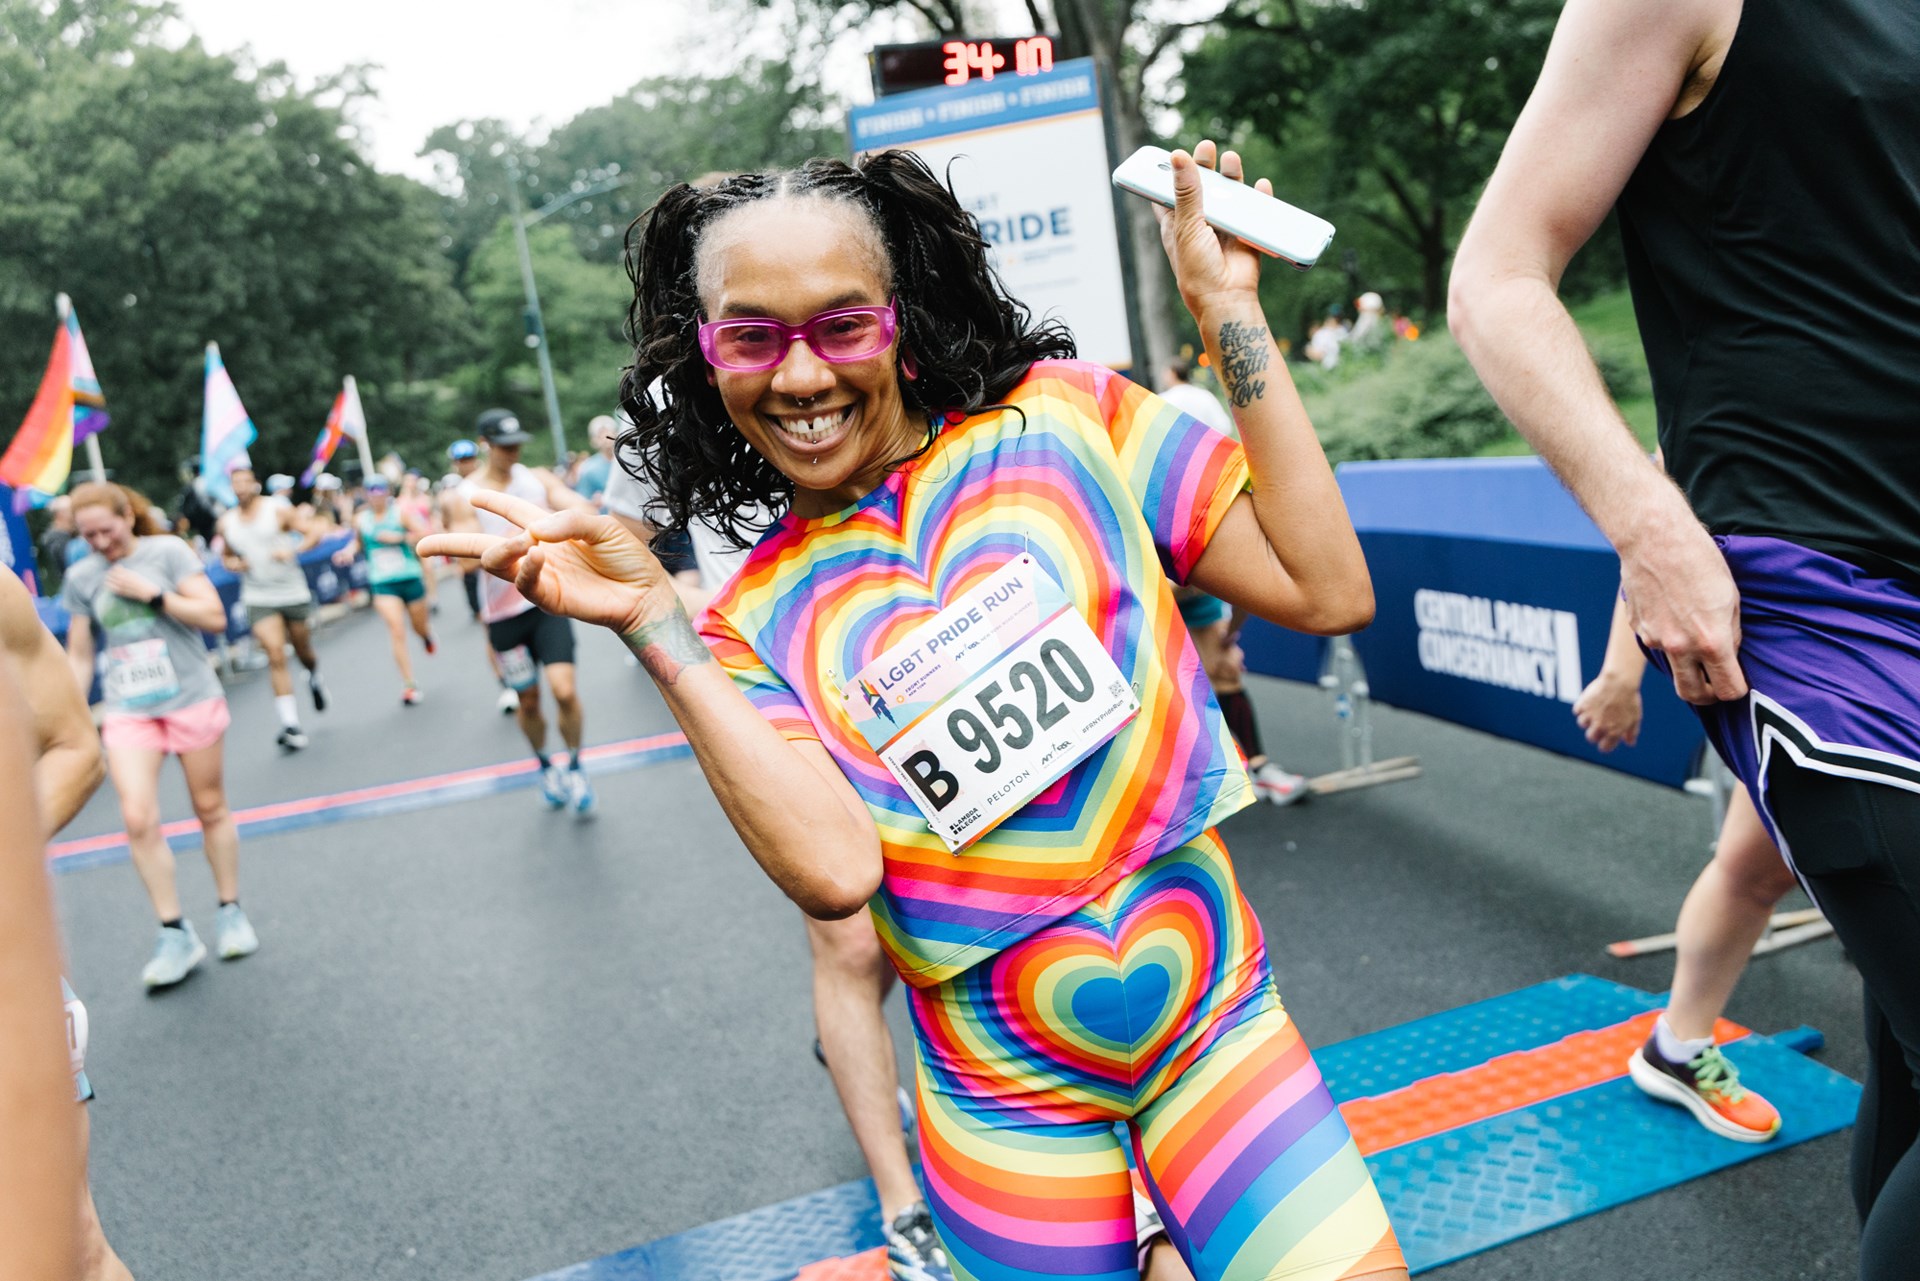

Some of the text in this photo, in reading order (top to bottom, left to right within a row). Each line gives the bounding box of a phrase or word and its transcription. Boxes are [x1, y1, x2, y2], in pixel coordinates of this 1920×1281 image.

[979, 206, 1072, 244] RIDE
[878, 577, 1024, 691] LGBT PRIDE RUN
[1494, 600, 1556, 653] PARK
[901, 749, 960, 812] B
[946, 638, 1095, 775] 9520
[1082, 700, 1124, 733] #FRNYPrideRun
[987, 769, 1031, 806] PELOTON
[953, 807, 978, 828] LAMBDA
[960, 813, 982, 830] LEGAL
